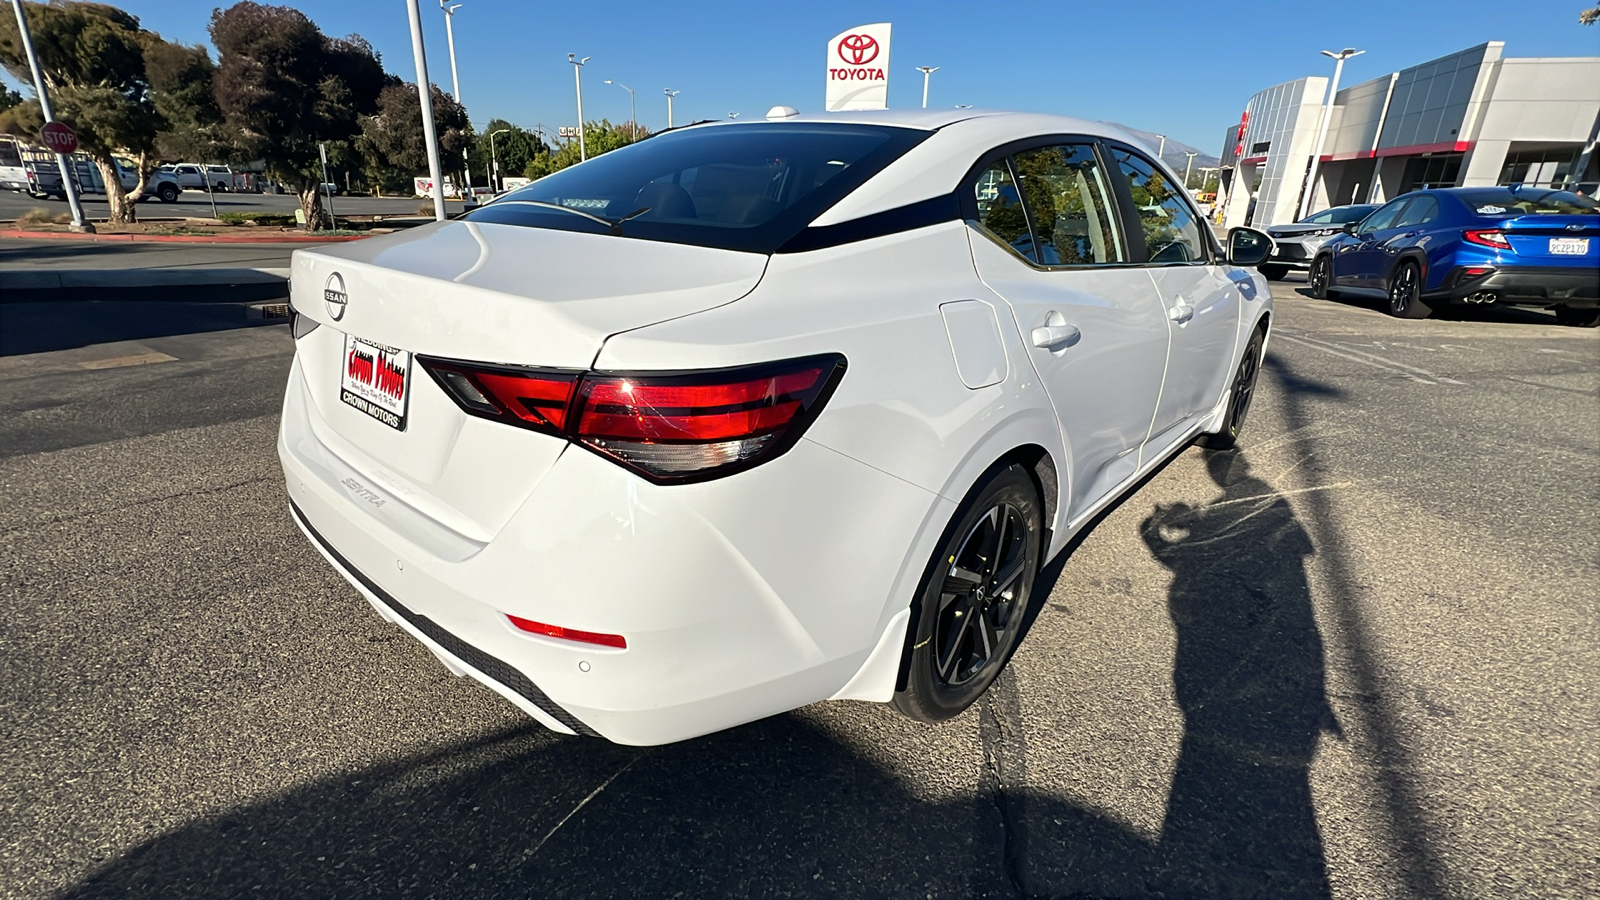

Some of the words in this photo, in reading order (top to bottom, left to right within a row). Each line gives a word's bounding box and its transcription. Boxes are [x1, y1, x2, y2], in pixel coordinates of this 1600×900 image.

[829, 68, 885, 81] TOYOTA
[43, 131, 75, 145] STOP
[1551, 244, 1586, 254] 9CZP170
[348, 348, 374, 386] Crown
[375, 349, 405, 401] Motors
[343, 391, 369, 412] CROWN
[368, 403, 399, 427] MOTORS
[341, 477, 387, 508] SENTRA
